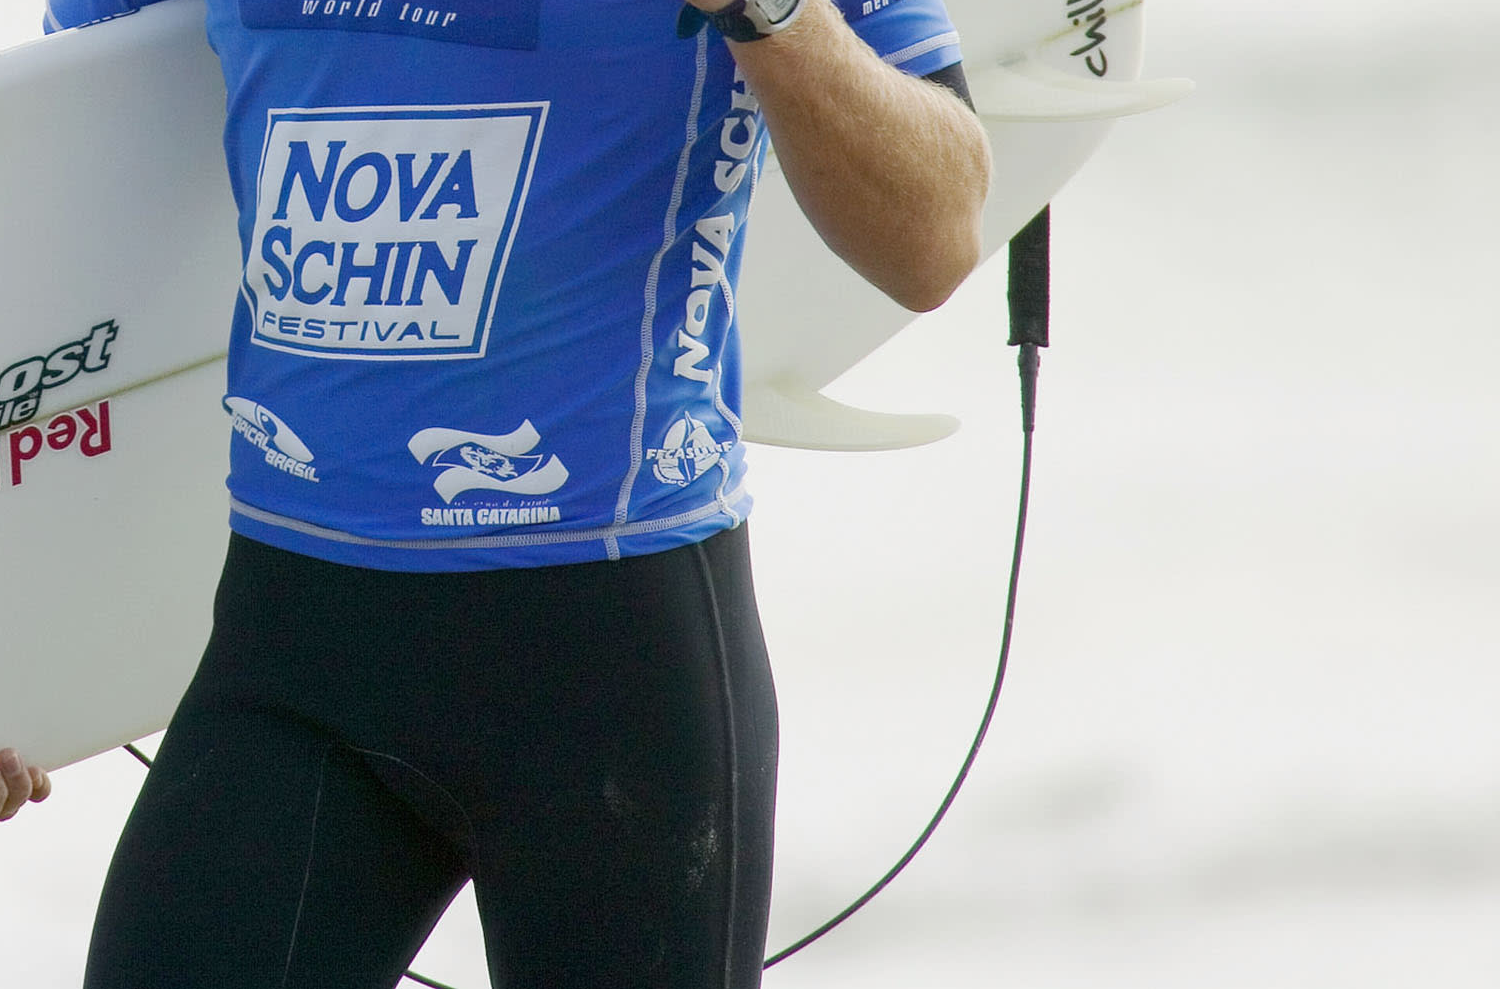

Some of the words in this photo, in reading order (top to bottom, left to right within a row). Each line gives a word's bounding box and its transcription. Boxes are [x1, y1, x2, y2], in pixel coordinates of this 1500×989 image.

[399, 2, 457, 27] tour
[272, 141, 479, 223] NOVA
[261, 225, 479, 307] SCHIN
[262, 311, 460, 342] FESTIVAL
[674, 212, 734, 384] NOVA
[10, 400, 111, 486] Red
[265, 448, 320, 483] BRASIL
[421, 508, 474, 526] SANTA
[477, 506, 560, 526] CATARINA
